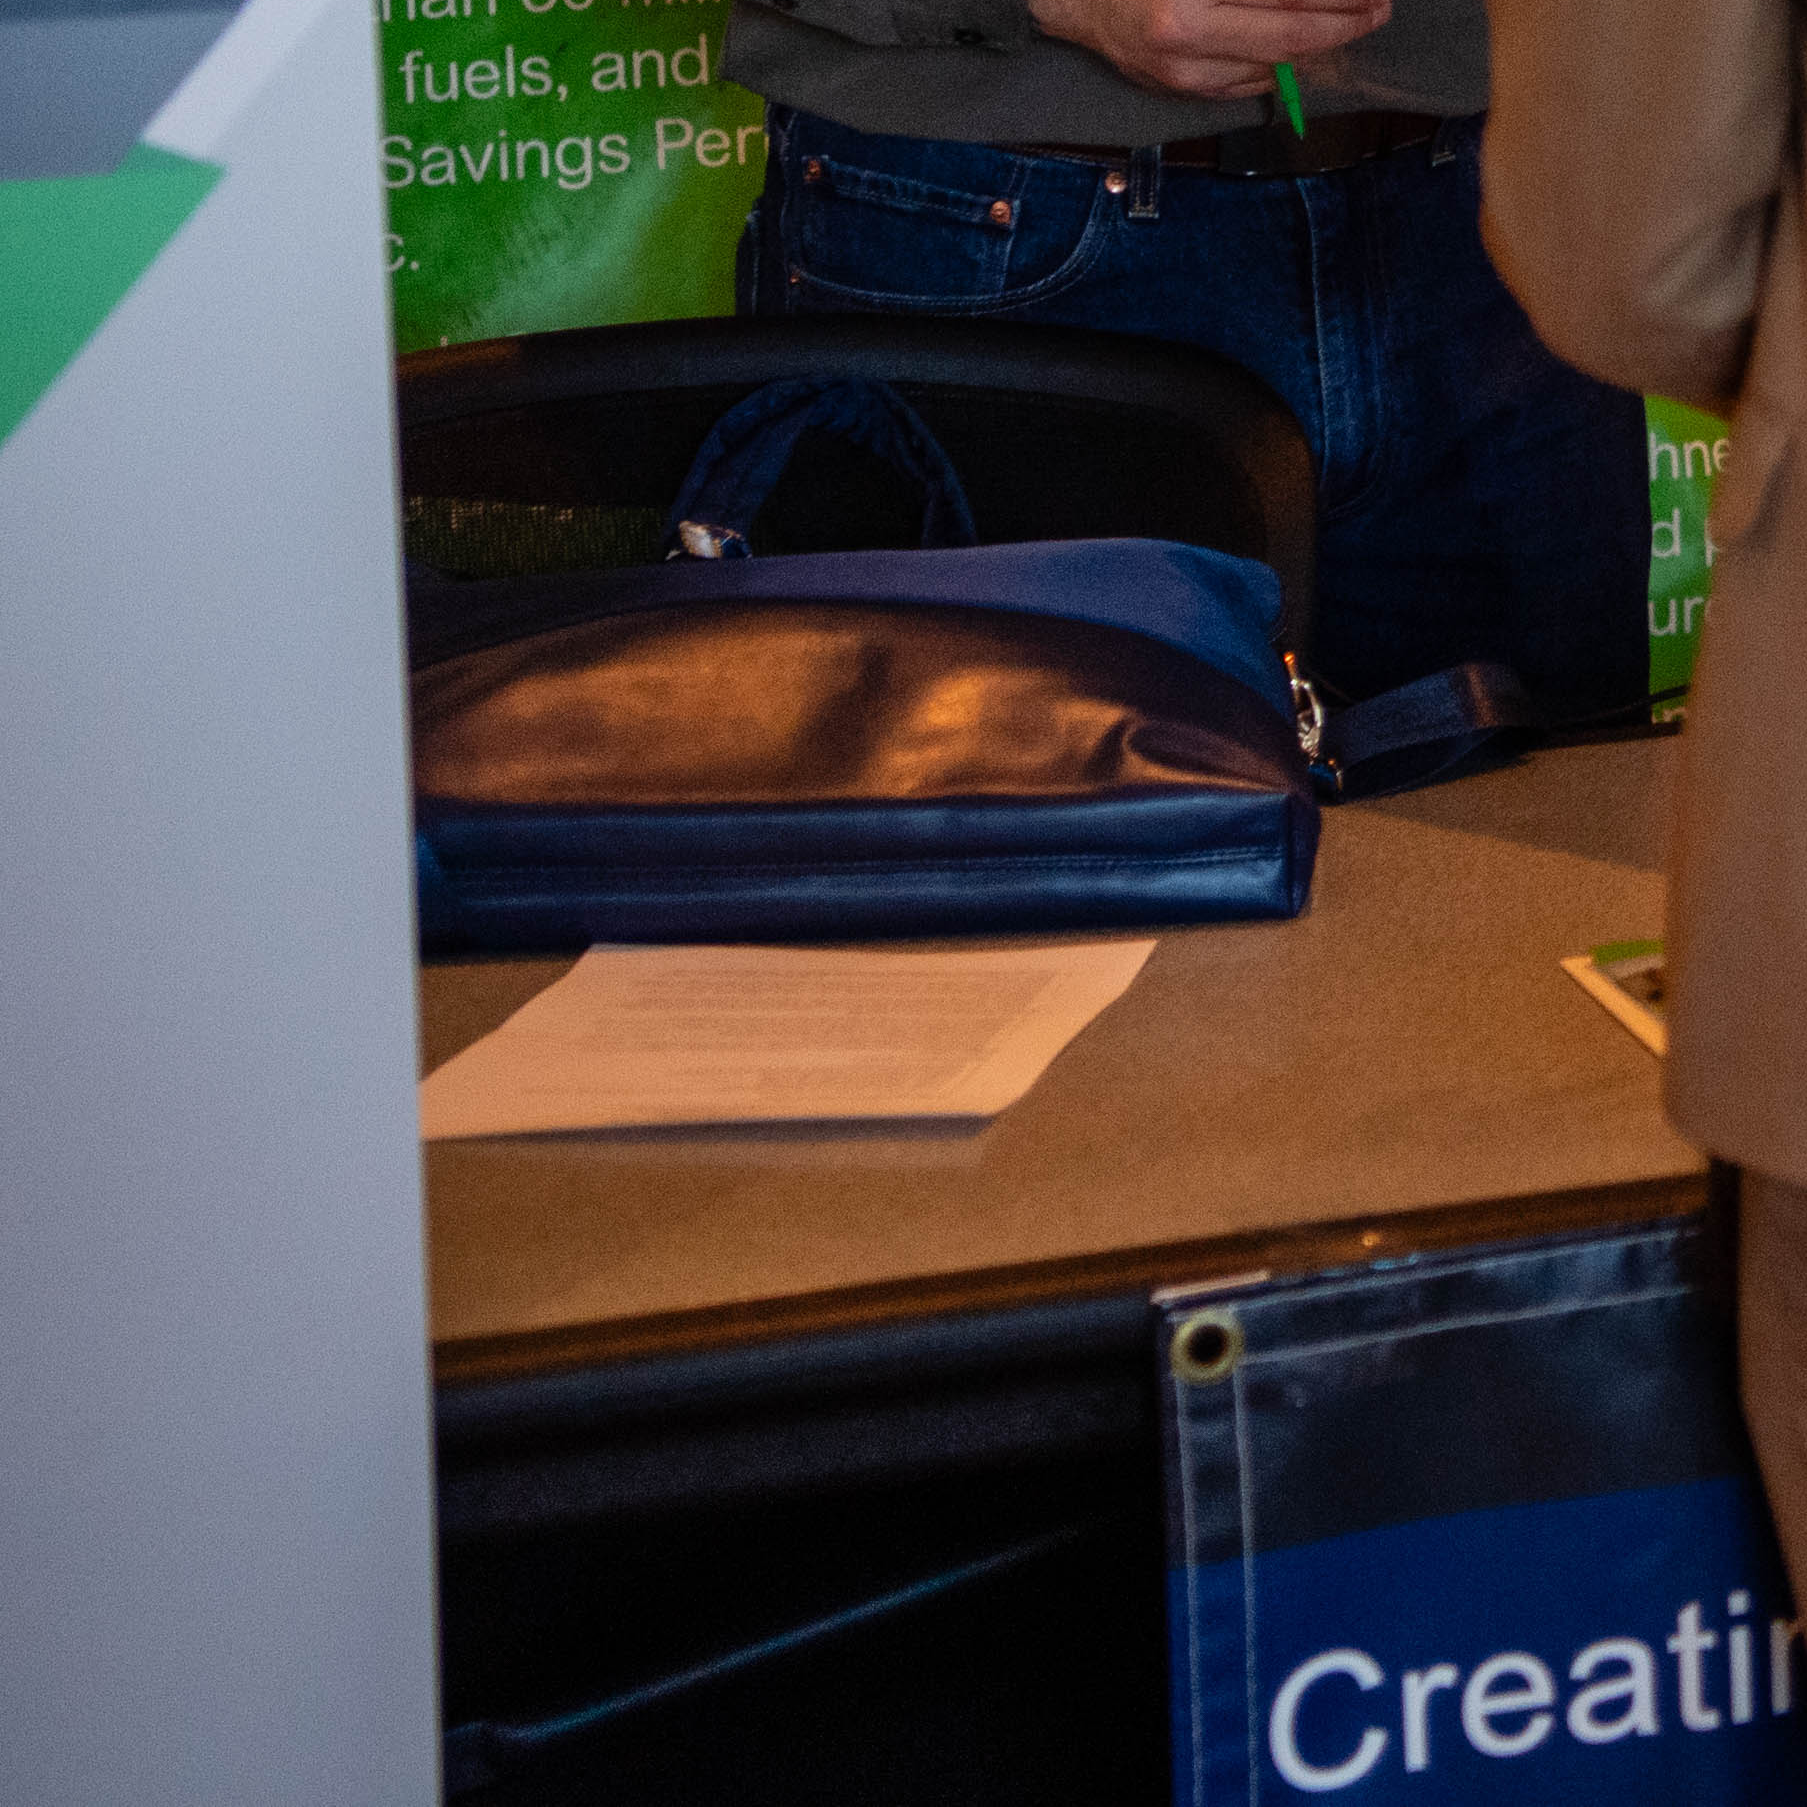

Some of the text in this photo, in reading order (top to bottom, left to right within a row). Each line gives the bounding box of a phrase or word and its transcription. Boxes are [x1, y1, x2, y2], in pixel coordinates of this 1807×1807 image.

[400, 33, 709, 104] fuels, and
[379, 117, 768, 191] Savings Per
